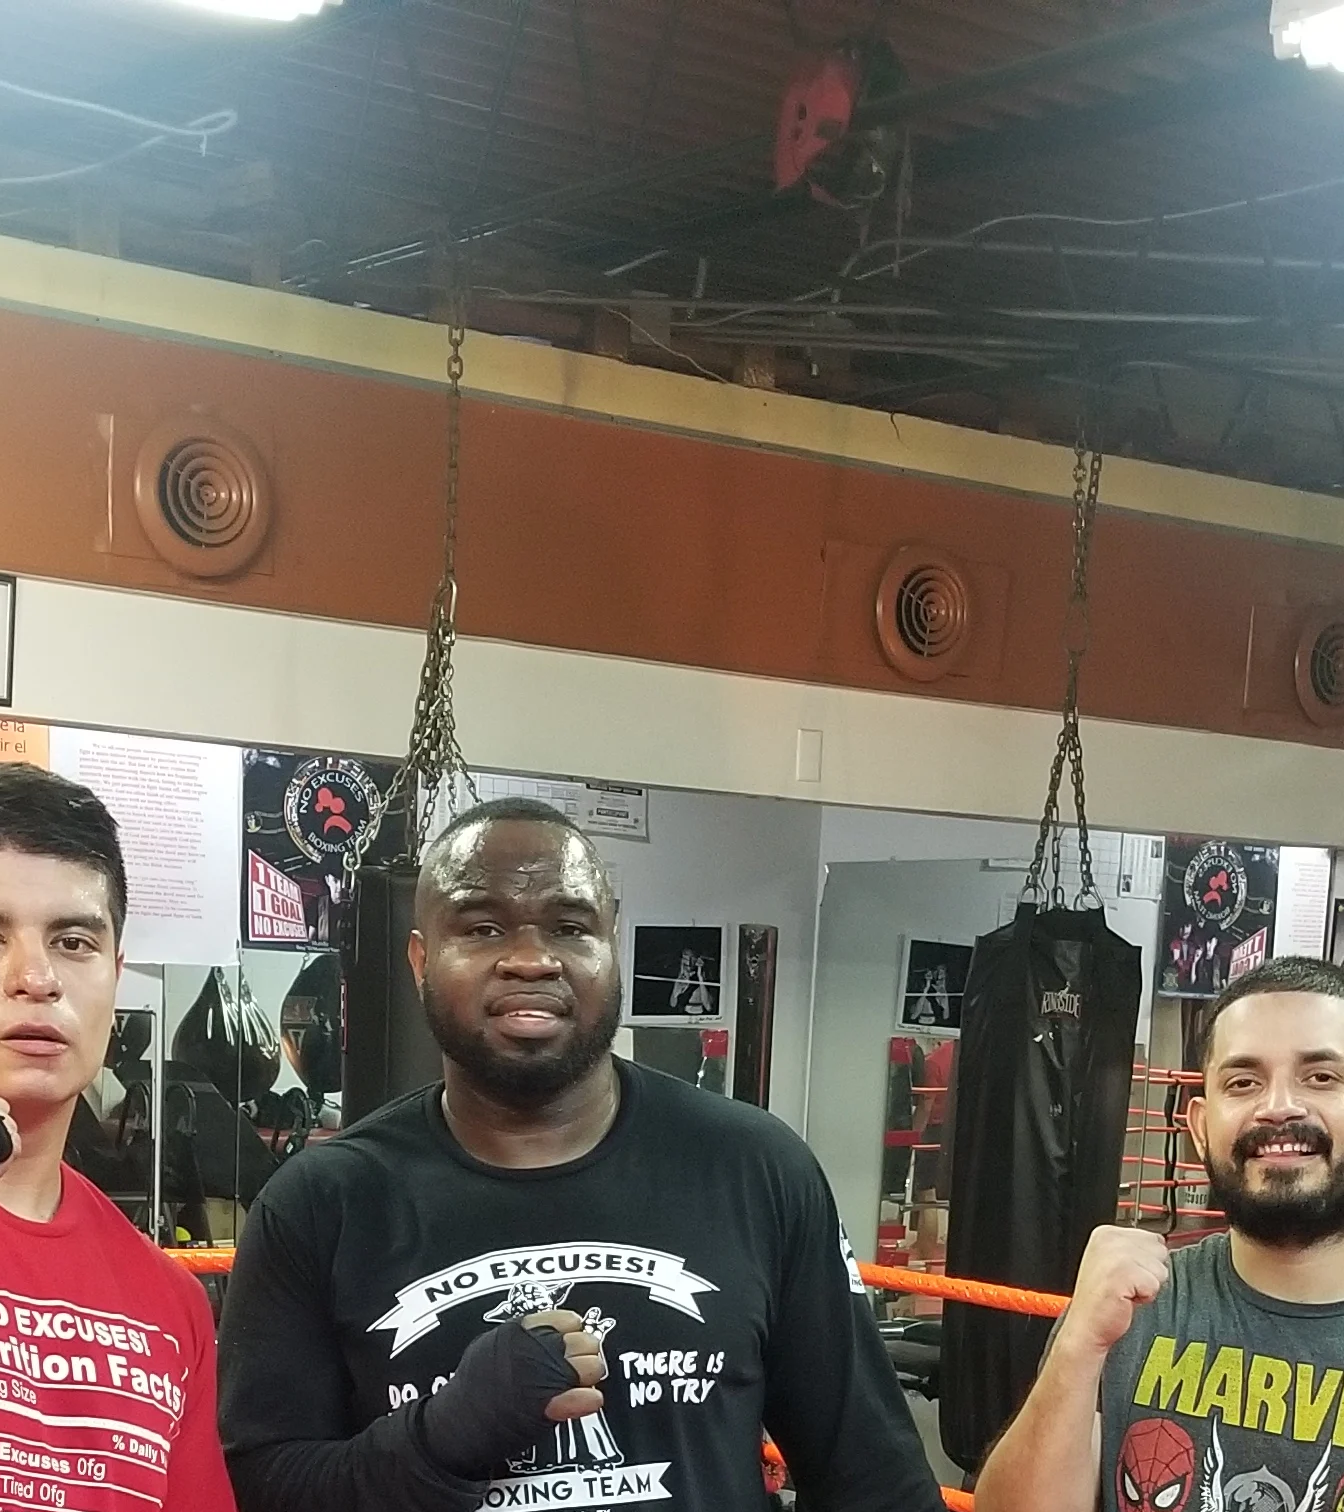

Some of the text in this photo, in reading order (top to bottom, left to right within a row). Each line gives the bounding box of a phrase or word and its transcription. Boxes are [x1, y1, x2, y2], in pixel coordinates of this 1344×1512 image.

[14, 740, 27, 753] el
[299, 771, 365, 814] NO EXCUSES
[307, 831, 347, 853] BOXING
[267, 866, 301, 903] TEAM
[271, 893, 303, 921] GOAL
[254, 915, 307, 938] NO EXCUSES
[425, 1252, 656, 1305] NO EXCUSES!
[15, 1307, 152, 1358] EXCUSES!
[619, 1350, 725, 1378] THERE IS
[11, 1378, 38, 1405] Size
[107, 1354, 182, 1413] Facts
[388, 1382, 419, 1410] DO
[628, 1377, 716, 1409] NO TRY
[112, 1434, 158, 1464] % Daily
[0, 1474, 35, 1501] Tired
[582, 1472, 652, 1499] TEAM
